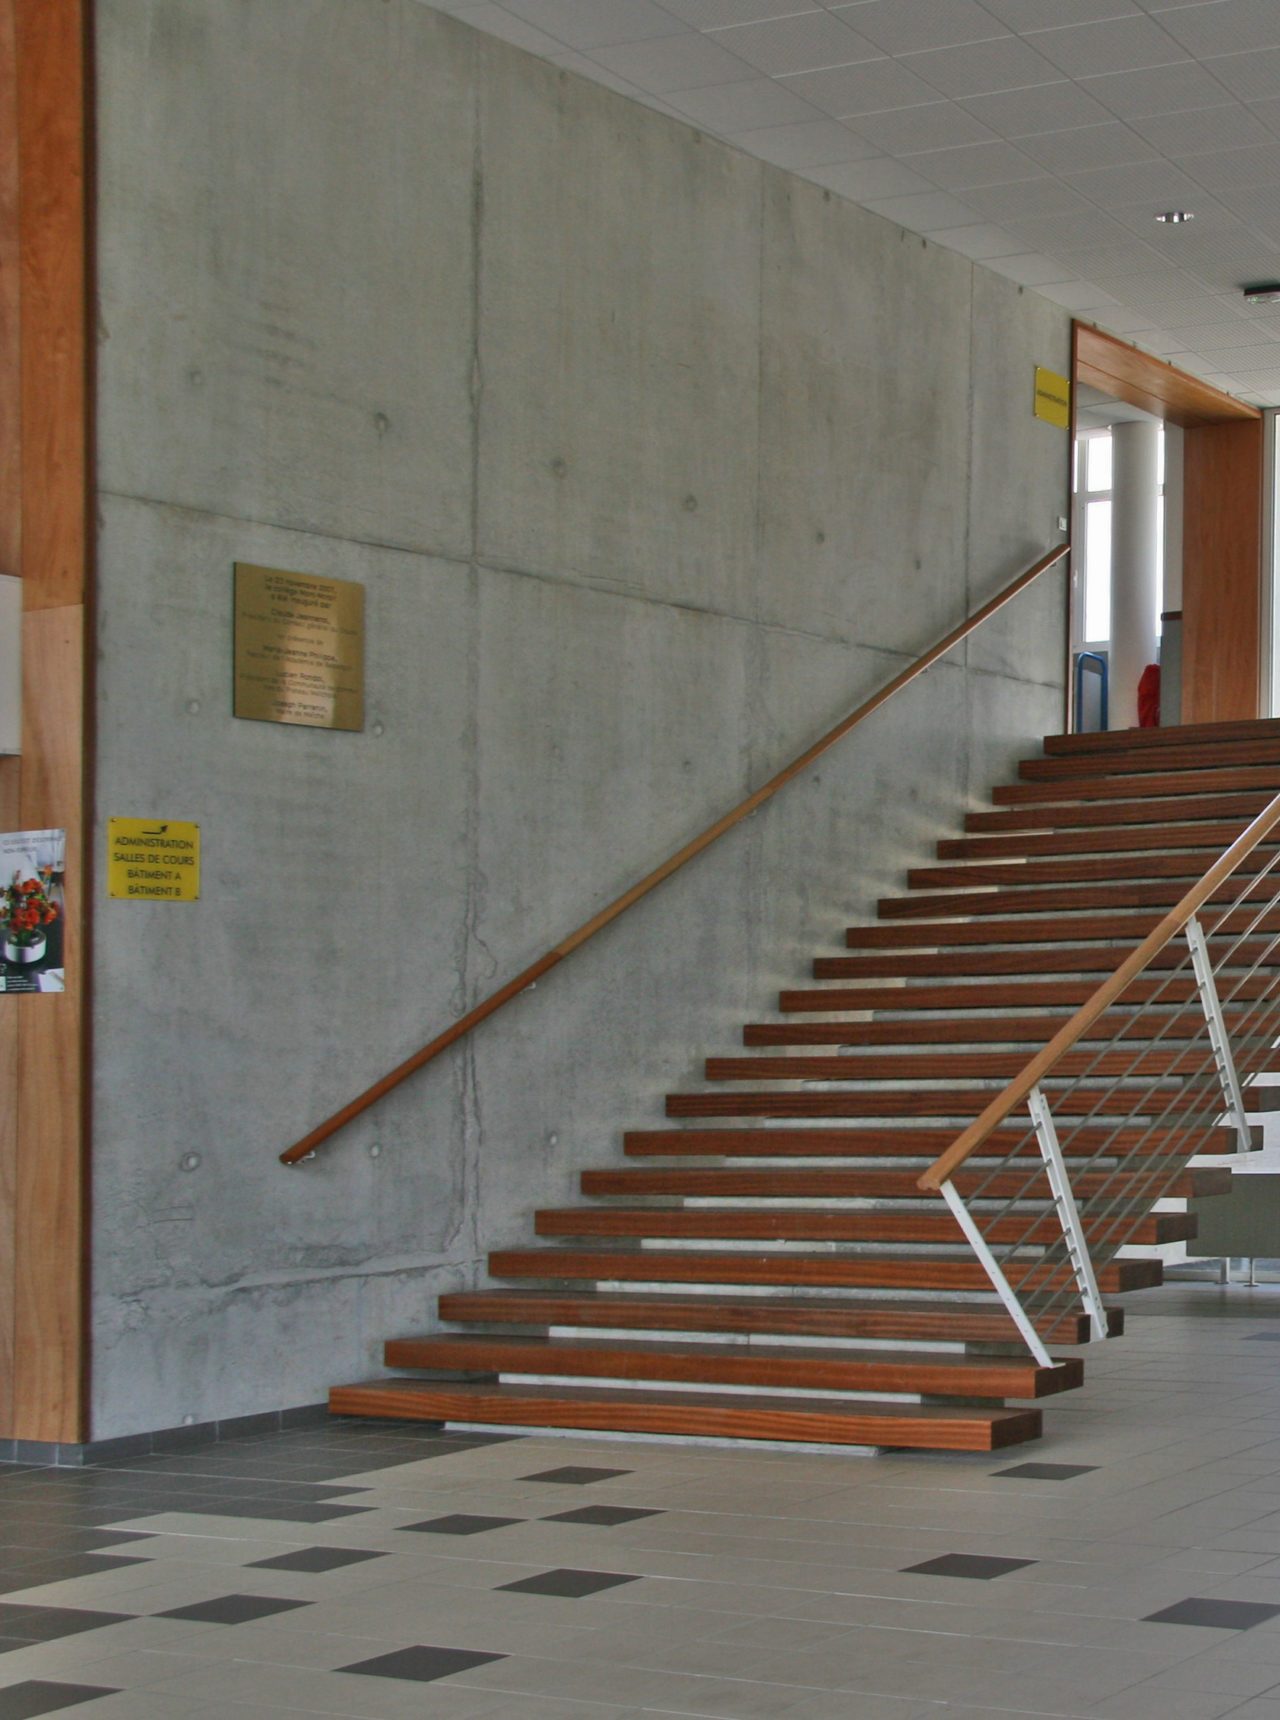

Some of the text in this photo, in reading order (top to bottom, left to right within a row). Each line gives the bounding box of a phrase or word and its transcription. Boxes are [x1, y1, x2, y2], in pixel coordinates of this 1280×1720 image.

[115, 836, 194, 850] ADMINISTRATION
[113, 852, 195, 866] SALLES DE COURS
[175, 871, 183, 881] A
[175, 887, 183, 897] B
